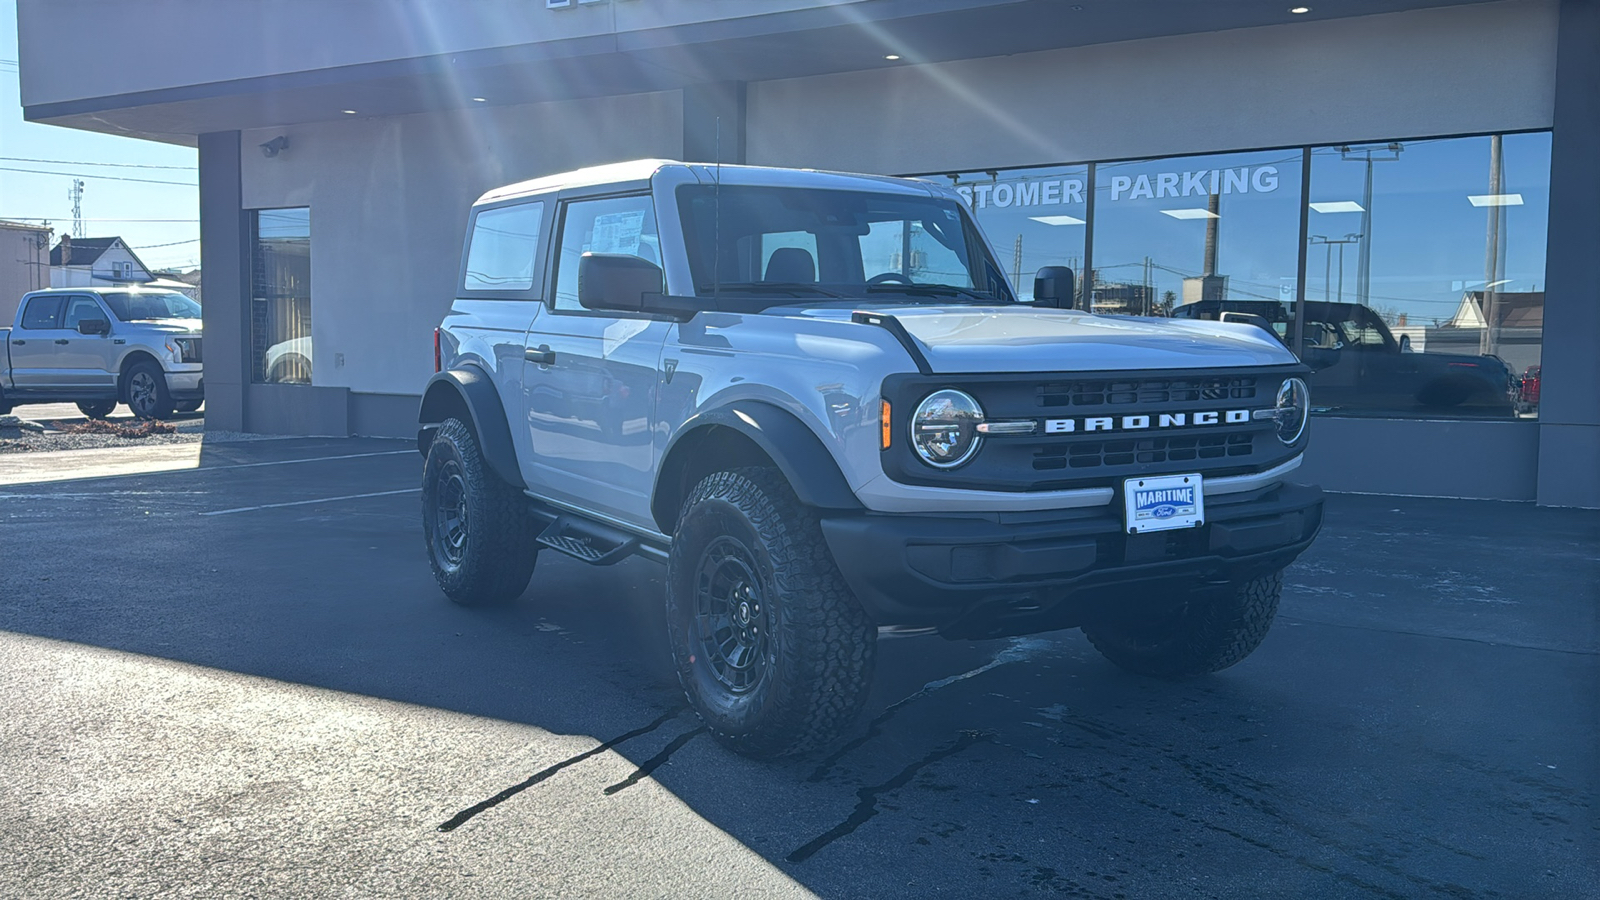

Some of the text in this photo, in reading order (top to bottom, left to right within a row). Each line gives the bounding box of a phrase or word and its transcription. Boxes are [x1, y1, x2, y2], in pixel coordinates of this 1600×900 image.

[1111, 166, 1279, 200] PARKING
[1045, 410, 1249, 433] BRONCO
[1136, 488, 1193, 509] MARITIME
[1156, 507, 1173, 517] Ford
